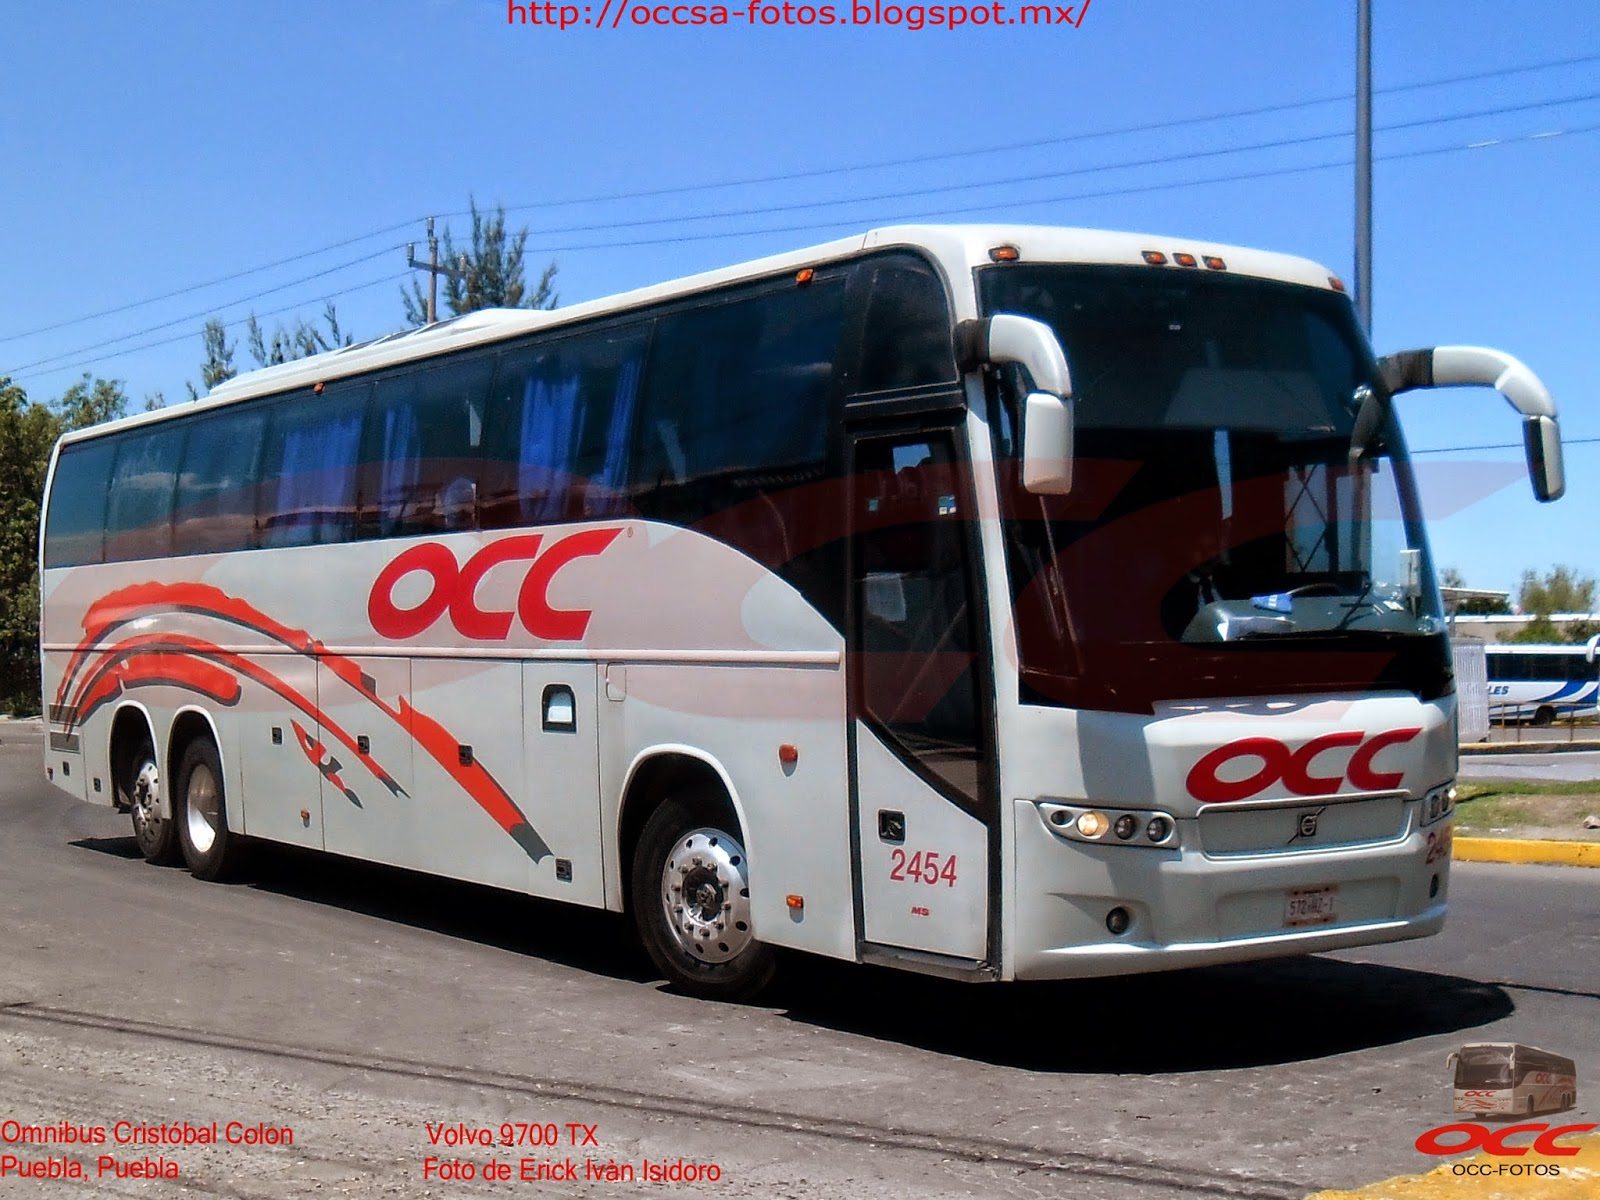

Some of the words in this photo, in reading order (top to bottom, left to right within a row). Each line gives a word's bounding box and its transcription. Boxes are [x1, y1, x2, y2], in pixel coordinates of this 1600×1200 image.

[367, 527, 625, 641] OCC
[1185, 727, 1422, 802] OCC
[889, 848, 957, 888] 2454
